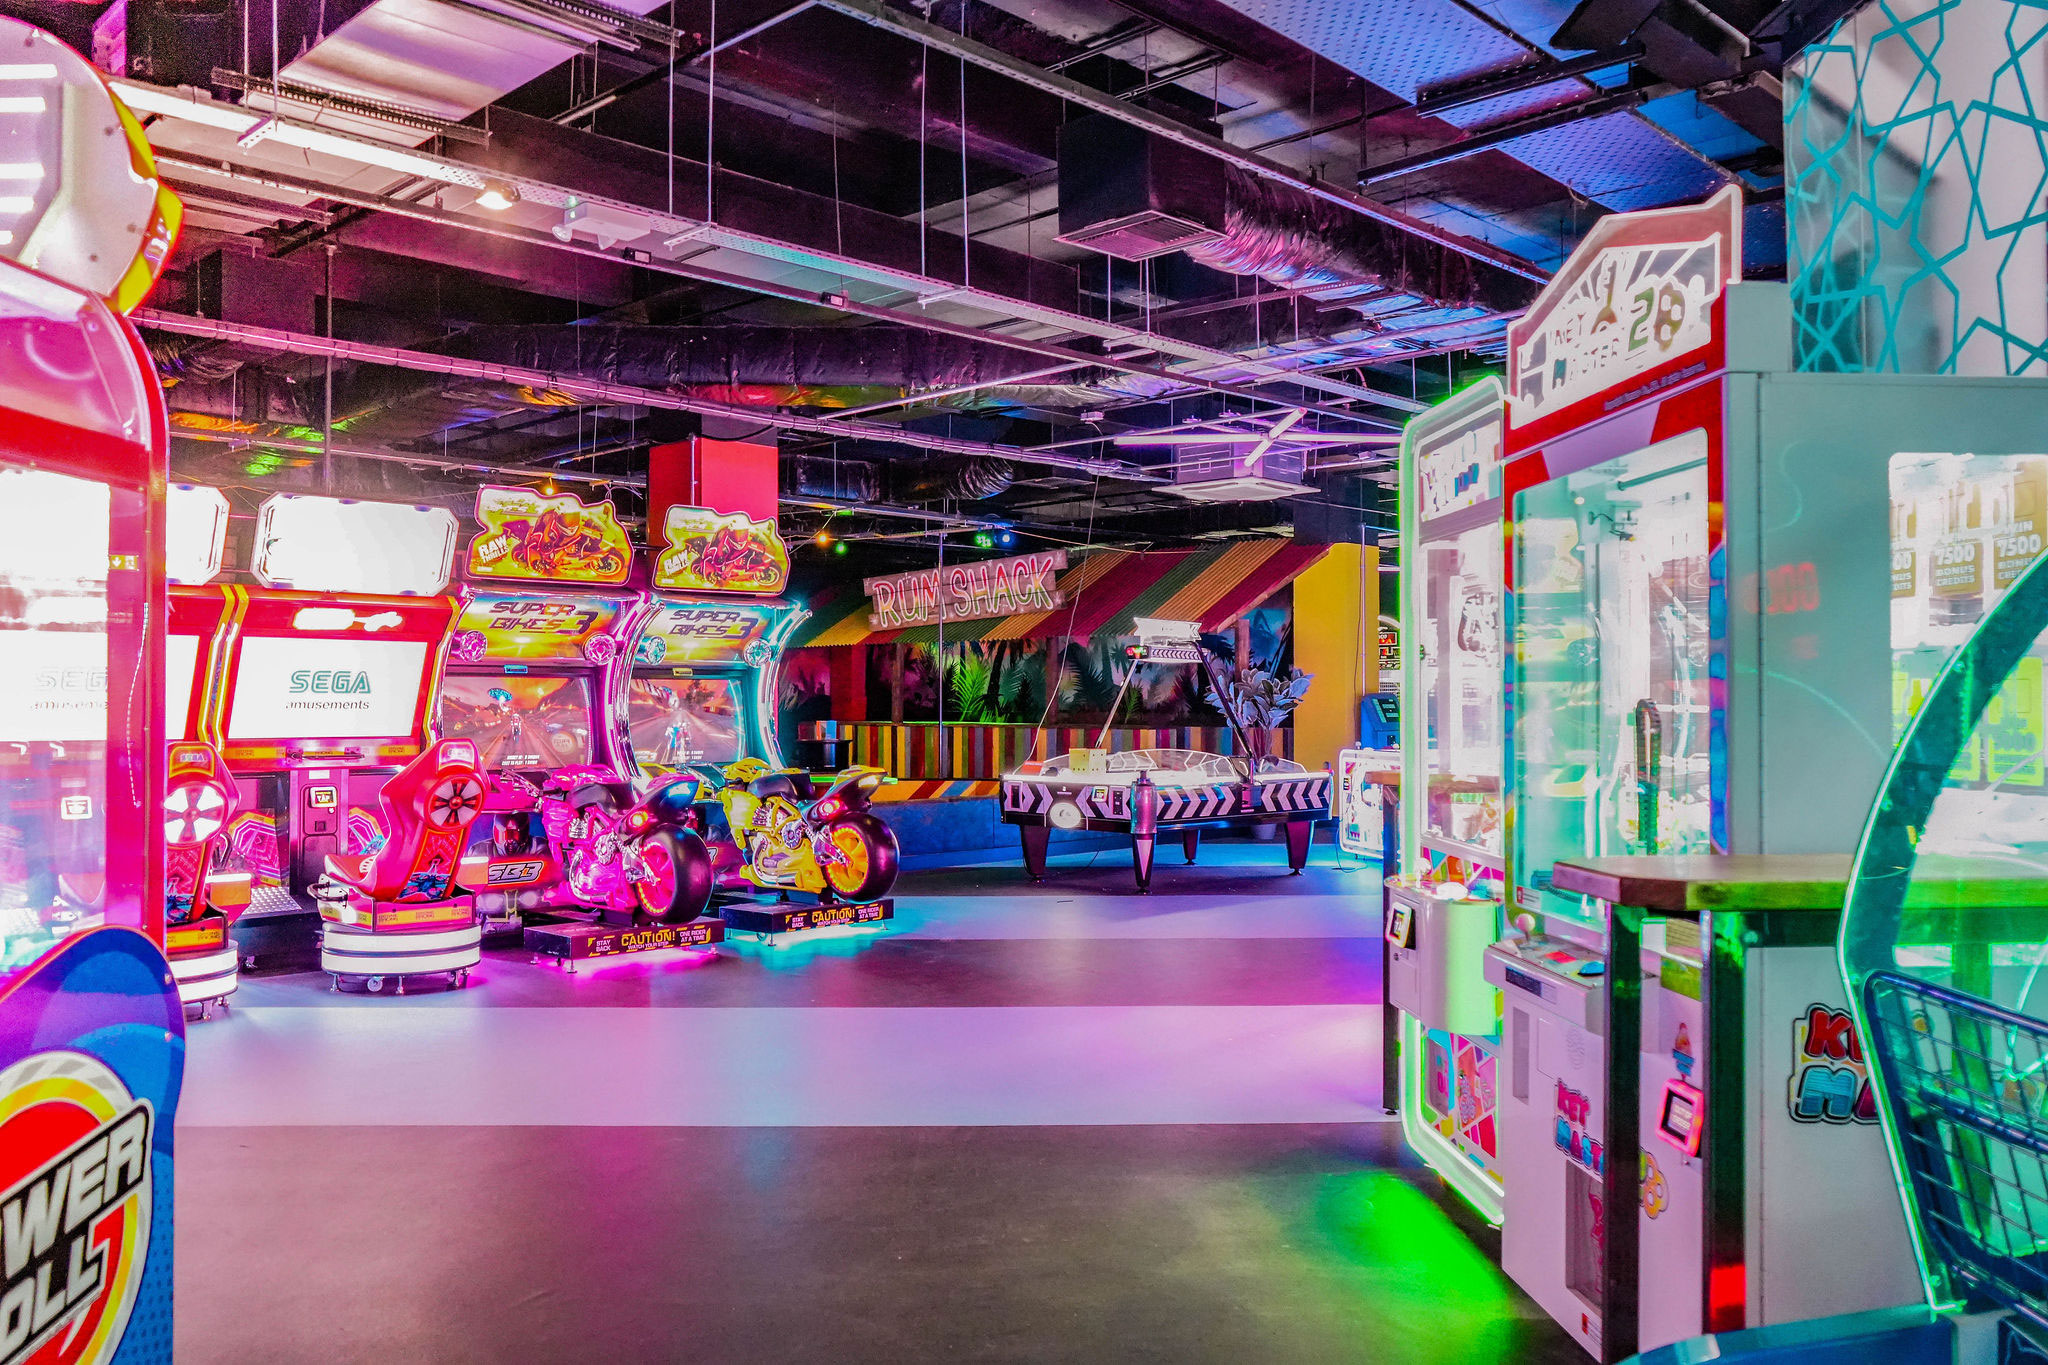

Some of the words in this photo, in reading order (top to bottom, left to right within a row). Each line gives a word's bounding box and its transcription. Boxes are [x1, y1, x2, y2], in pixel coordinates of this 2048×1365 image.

[478, 535, 507, 558] RAW
[664, 549, 688, 571] RAW
[1936, 544, 1976, 566] 7500
[1936, 565, 1976, 577] BONUS
[872, 570, 946, 628] RUM
[951, 556, 1053, 617] SHACK
[489, 601, 576, 616] SUPER
[669, 609, 741, 623] SUPER
[488, 617, 565, 632] BIKES
[668, 624, 732, 636] BIKES
[289, 670, 371, 693] SEGA
[286, 700, 370, 710] amusements
[812, 908, 855, 923] CAUTION!
[621, 931, 675, 946] CAUTION!
